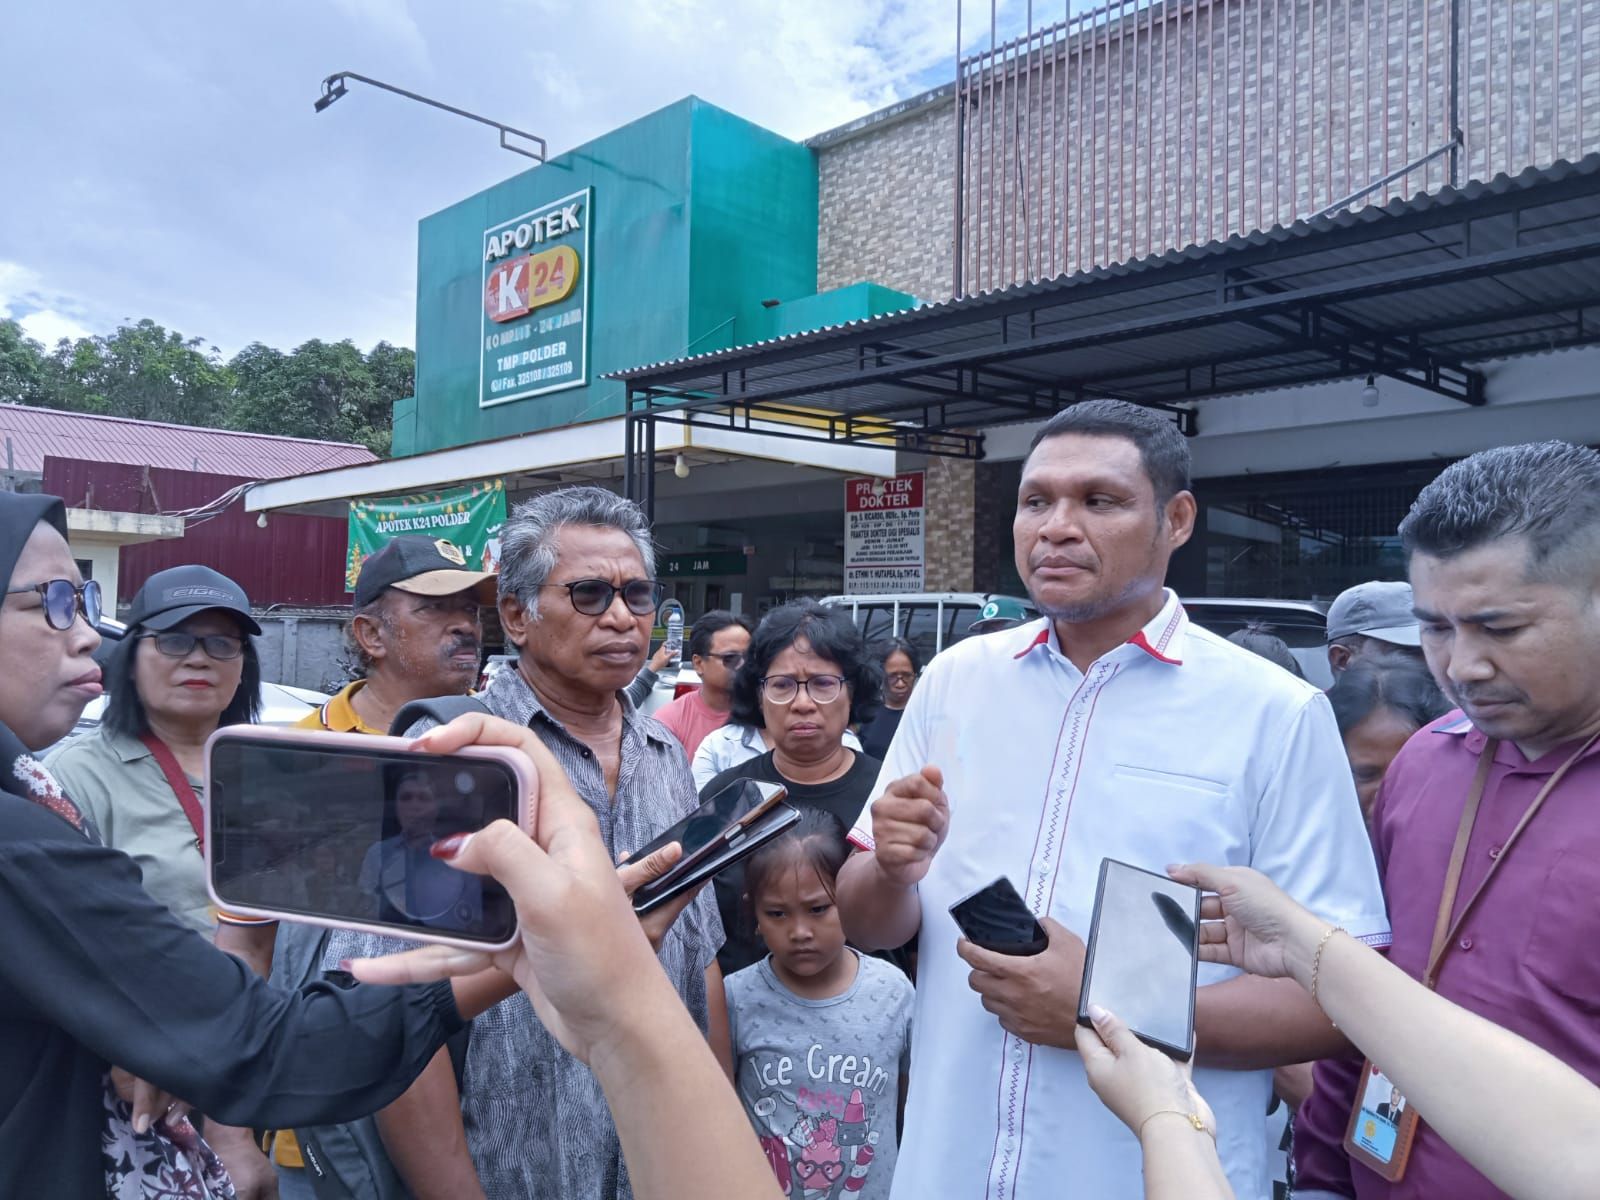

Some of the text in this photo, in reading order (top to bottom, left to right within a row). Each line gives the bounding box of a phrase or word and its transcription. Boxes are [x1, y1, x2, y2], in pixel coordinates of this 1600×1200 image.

[486, 203, 580, 261] APOTEK
[497, 341, 567, 372] TMP POLDER
[856, 479, 913, 495] PRKTEK
[860, 494, 909, 508] DOKTER
[375, 512, 471, 533] APOTEK K24 POLDER
[669, 560, 710, 572] 24 JAM
[749, 1043, 889, 1095] Ice Cream
